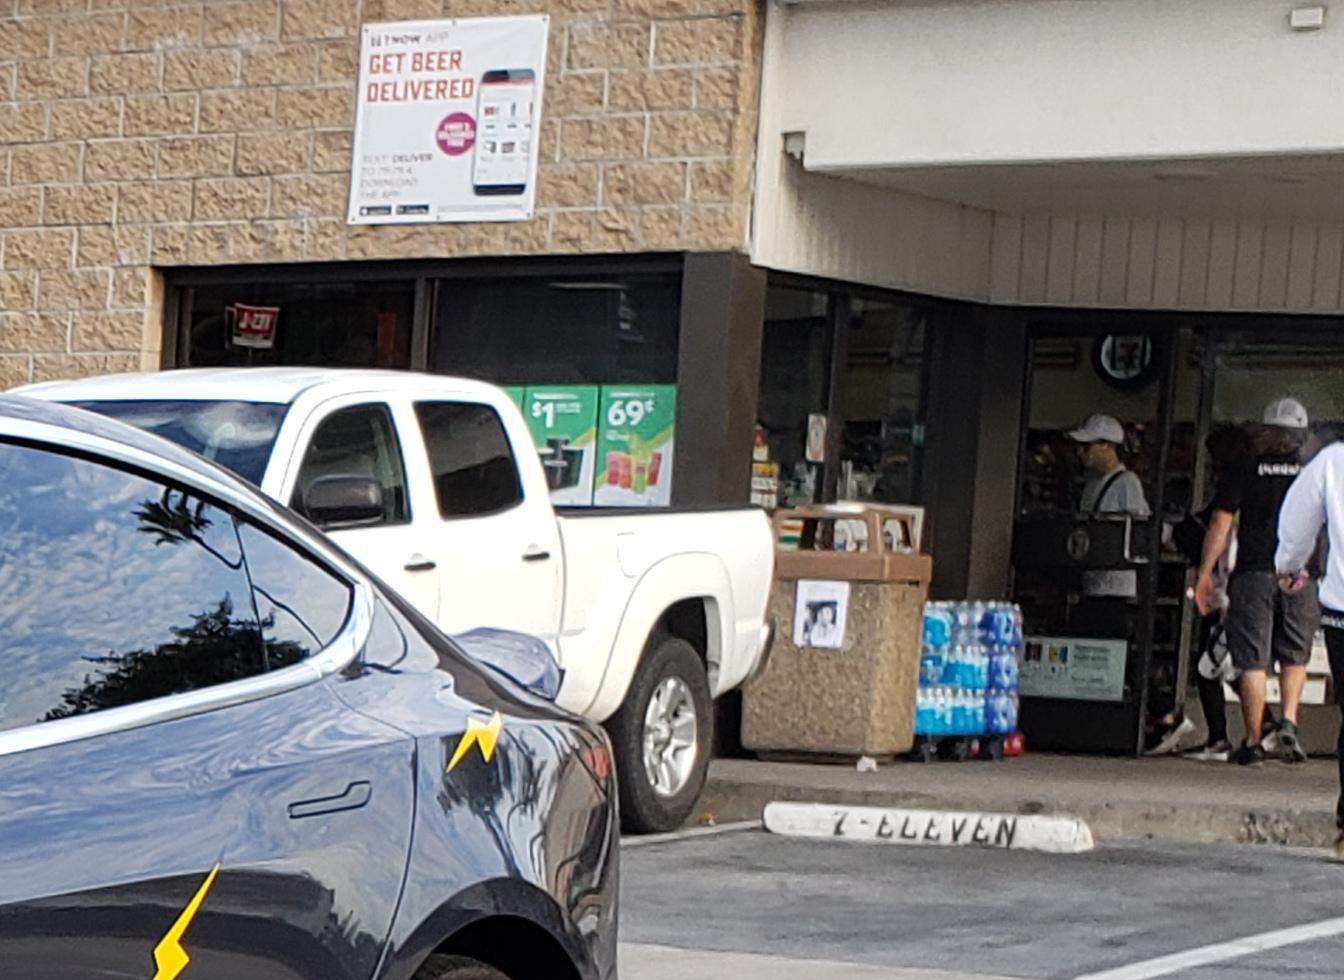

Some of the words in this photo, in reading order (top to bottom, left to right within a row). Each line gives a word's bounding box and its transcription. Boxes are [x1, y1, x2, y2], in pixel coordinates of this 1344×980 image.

[369, 53, 406, 74] GET
[412, 50, 462, 72] BEER
[367, 78, 475, 102] DELIVERED
[531, 401, 555, 429] $1
[608, 399, 655, 427] 69¢
